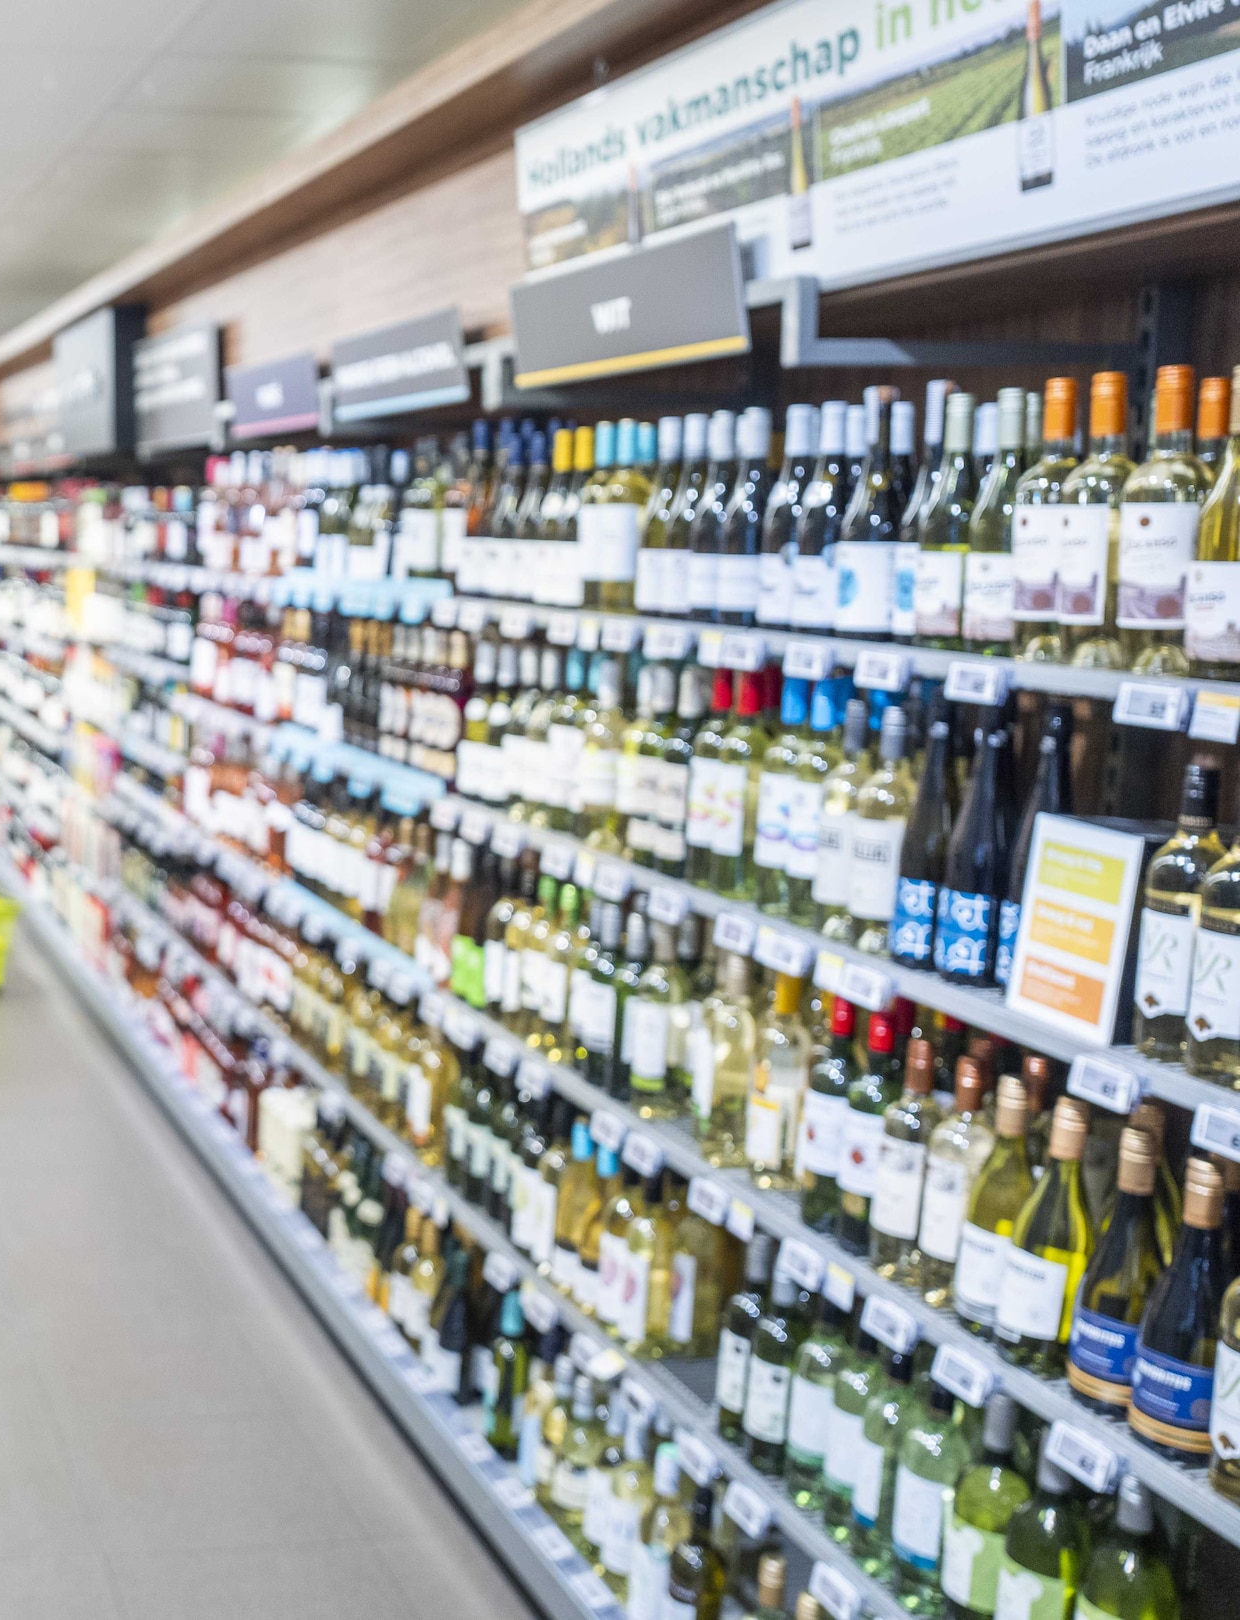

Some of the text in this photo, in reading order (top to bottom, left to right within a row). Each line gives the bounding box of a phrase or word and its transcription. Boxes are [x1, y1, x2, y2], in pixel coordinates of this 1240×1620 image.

[1133, 14, 1161, 42] en
[1083, 39, 1164, 86] Frankrijk
[526, 126, 626, 187] Hollands
[635, 28, 861, 146] vakmanschap
[875, 2, 912, 50] in
